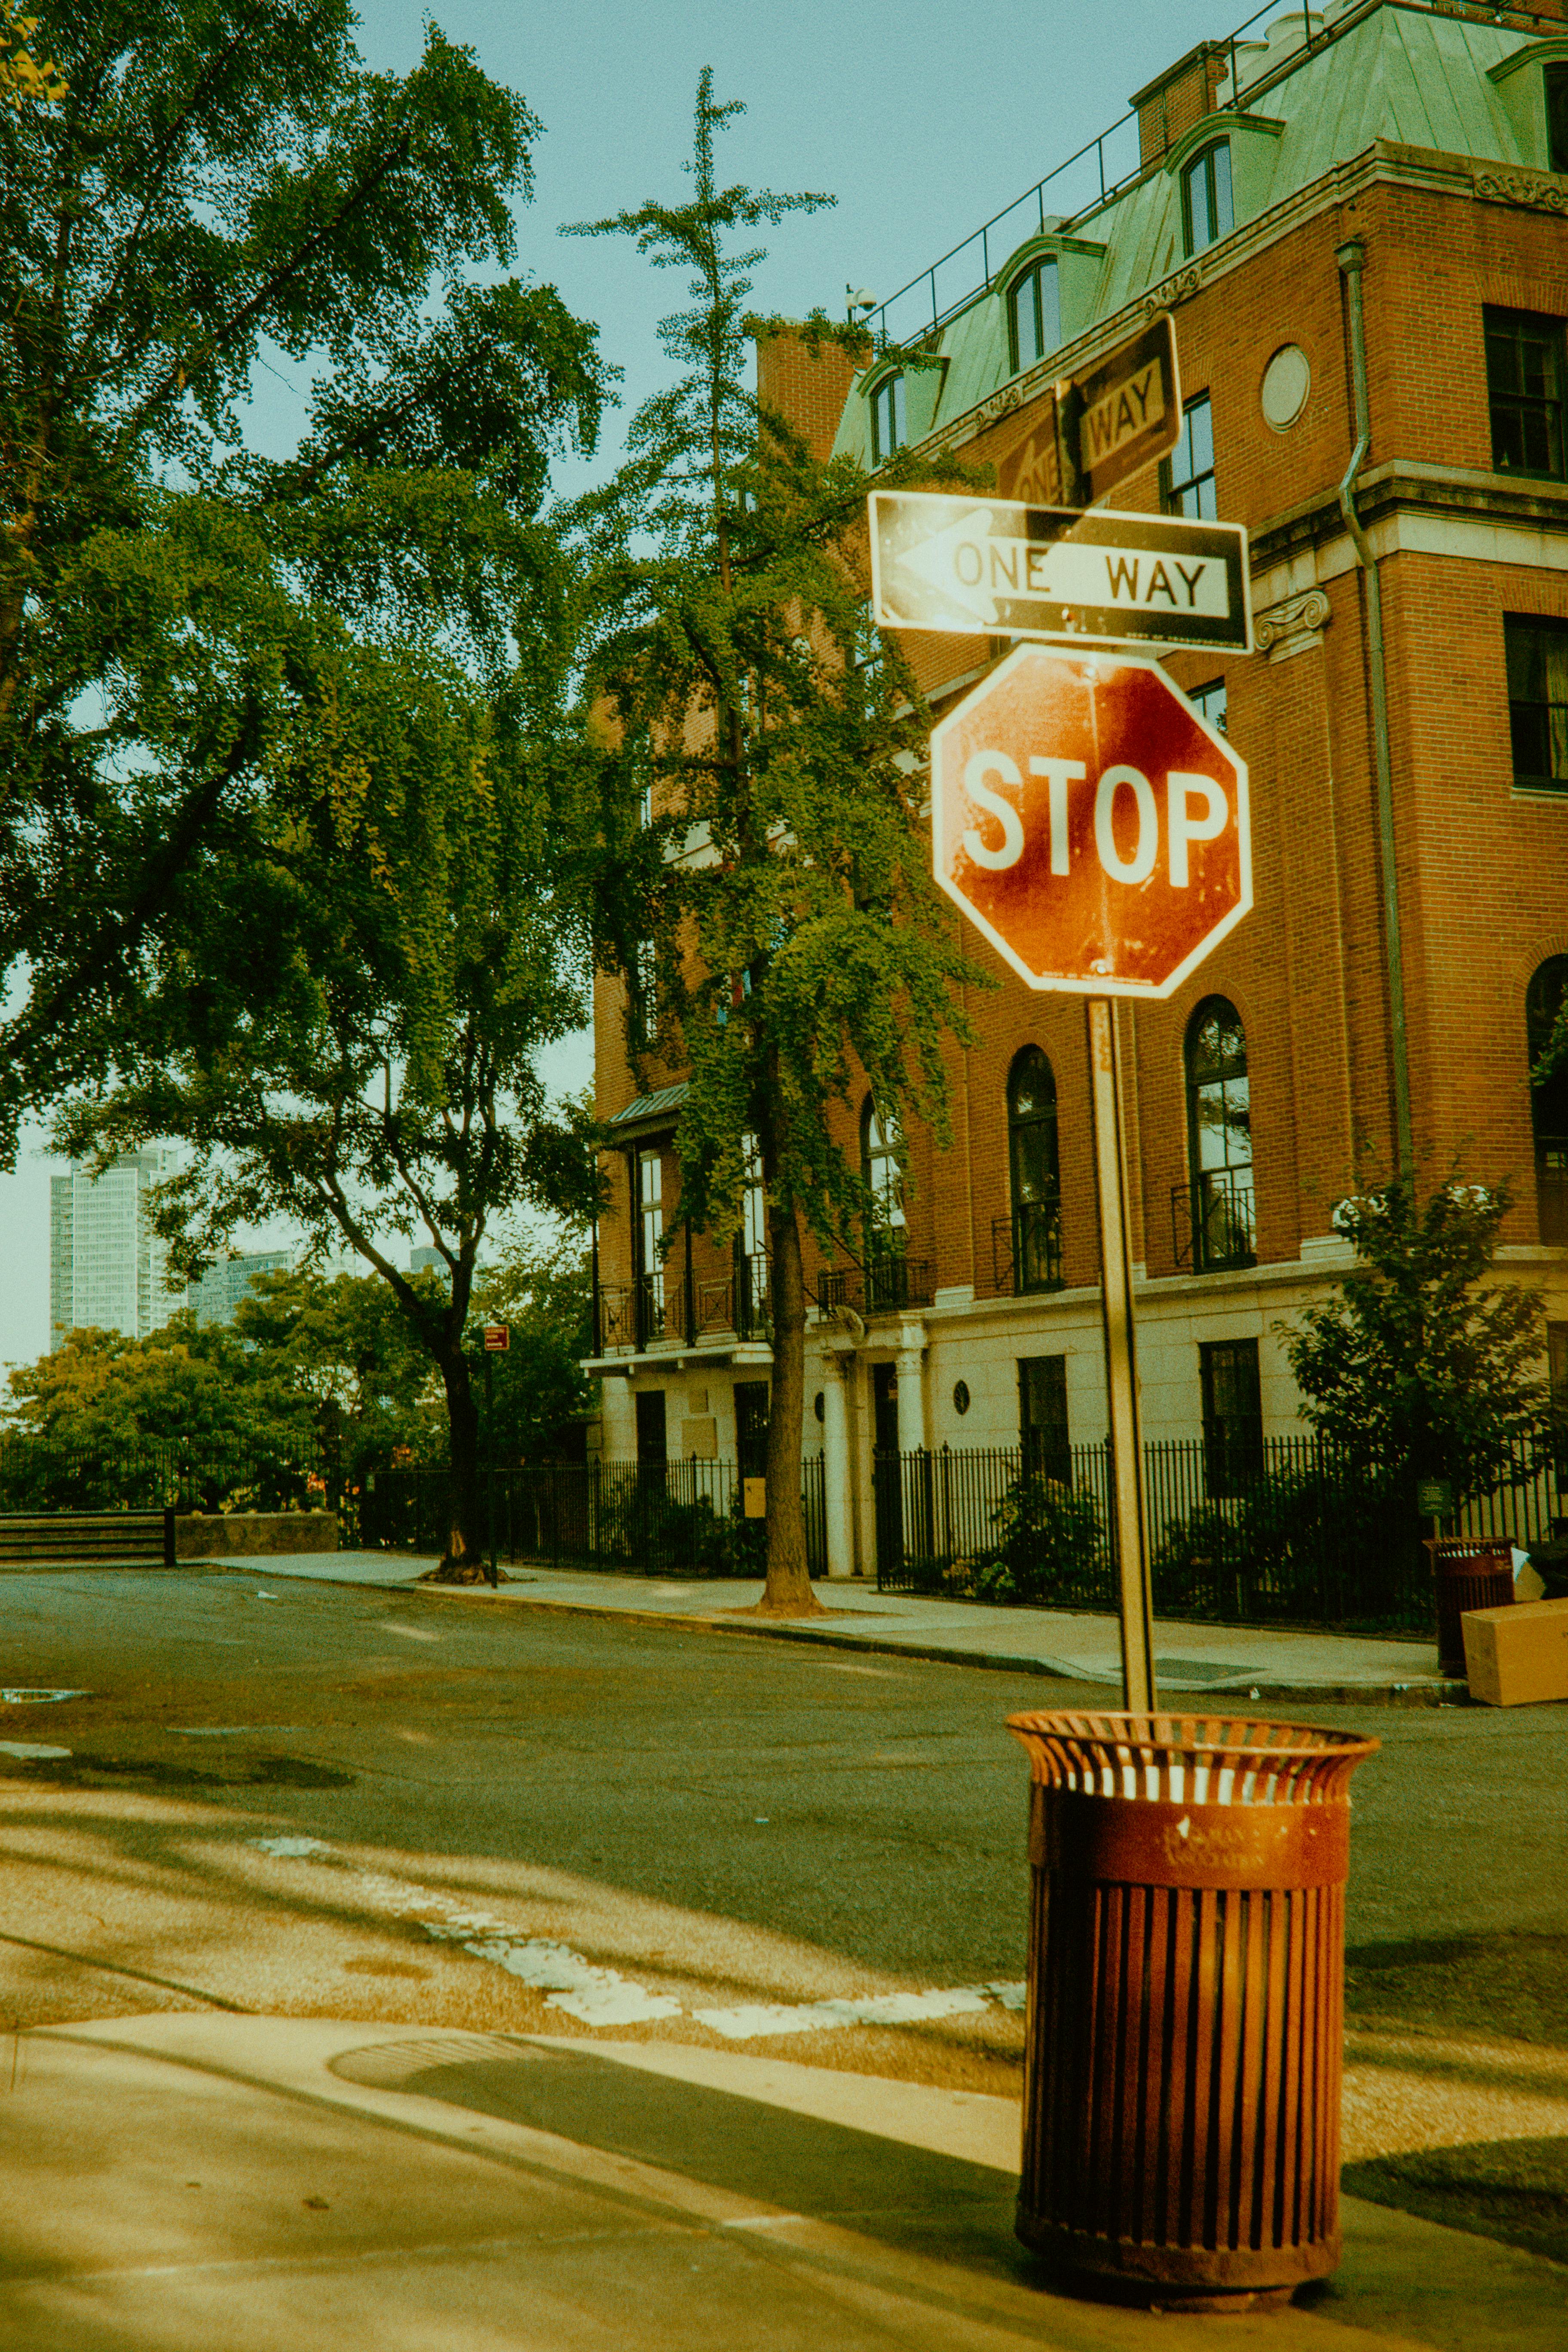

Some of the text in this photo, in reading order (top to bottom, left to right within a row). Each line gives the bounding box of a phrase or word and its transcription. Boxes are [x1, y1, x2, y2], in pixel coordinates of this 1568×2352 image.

[1090, 369, 1152, 456] WAY
[953, 541, 1206, 606] ONE WAY
[962, 749, 1228, 888] STOP
